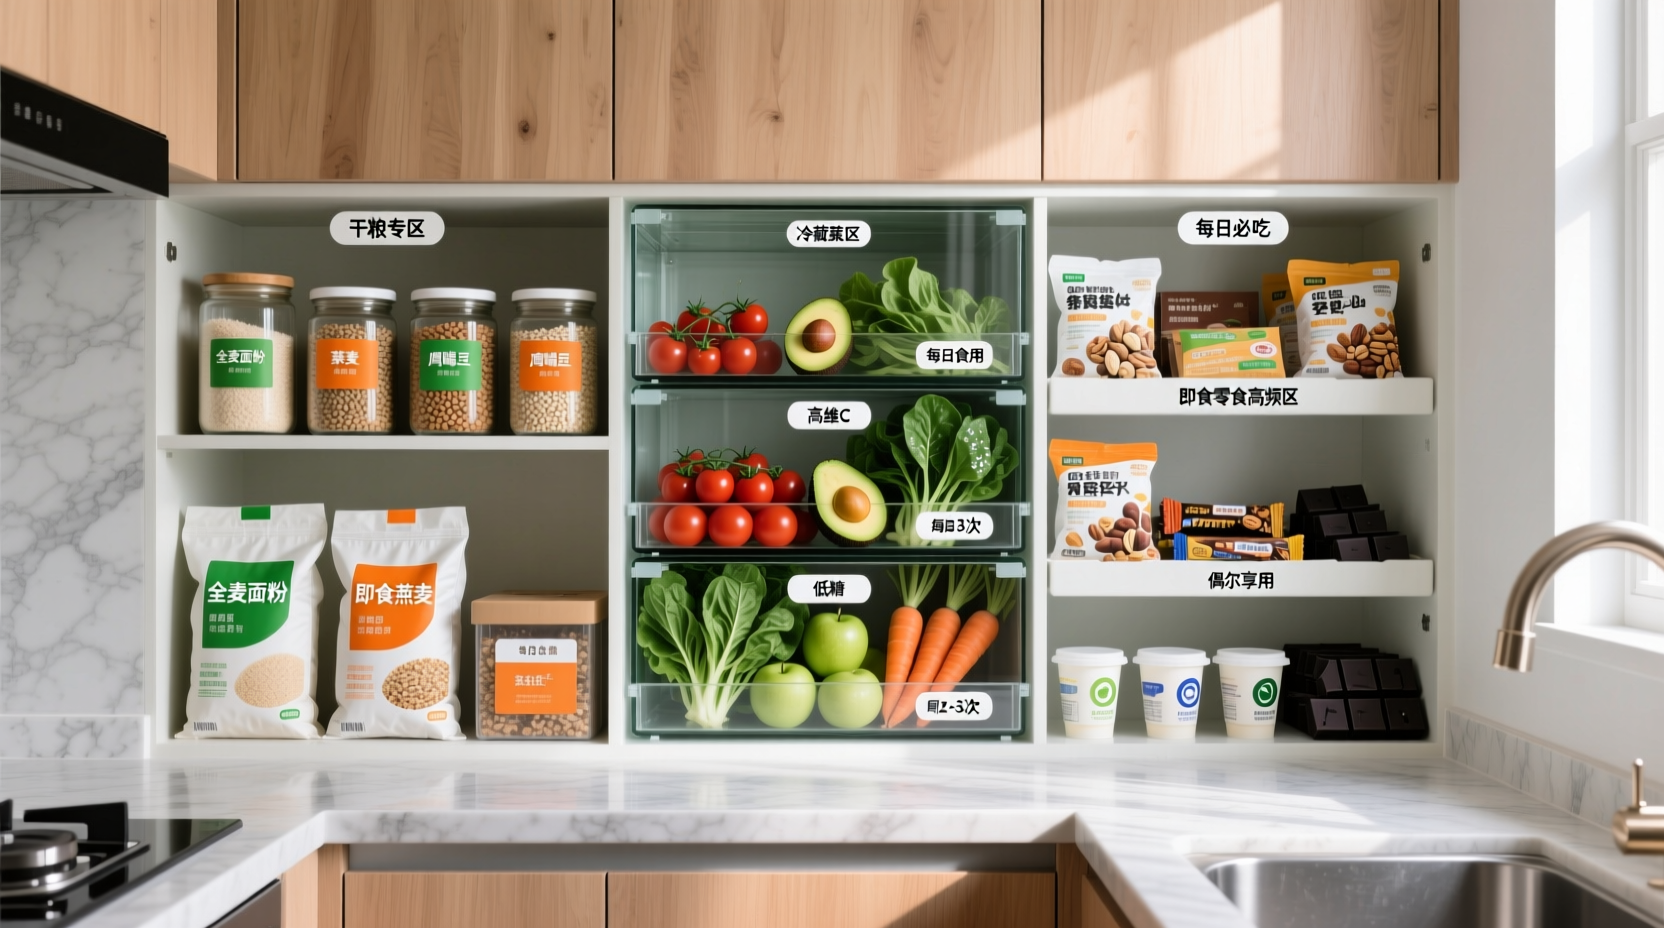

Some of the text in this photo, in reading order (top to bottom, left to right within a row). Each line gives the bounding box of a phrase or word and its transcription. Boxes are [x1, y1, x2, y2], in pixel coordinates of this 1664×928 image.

[349, 217, 425, 239] 干粮专区
[1196, 218, 1271, 238] 每日必吃
[926, 347, 984, 363] 每日食用
[1179, 386, 1299, 406] 即食零食高频区
[807, 406, 851, 424] 高维C
[813, 580, 845, 597] 低糖
[1208, 571, 1274, 590] 偶尔享用
[207, 580, 288, 604] 全麦面粉
[355, 582, 433, 605] 即食燕麦
